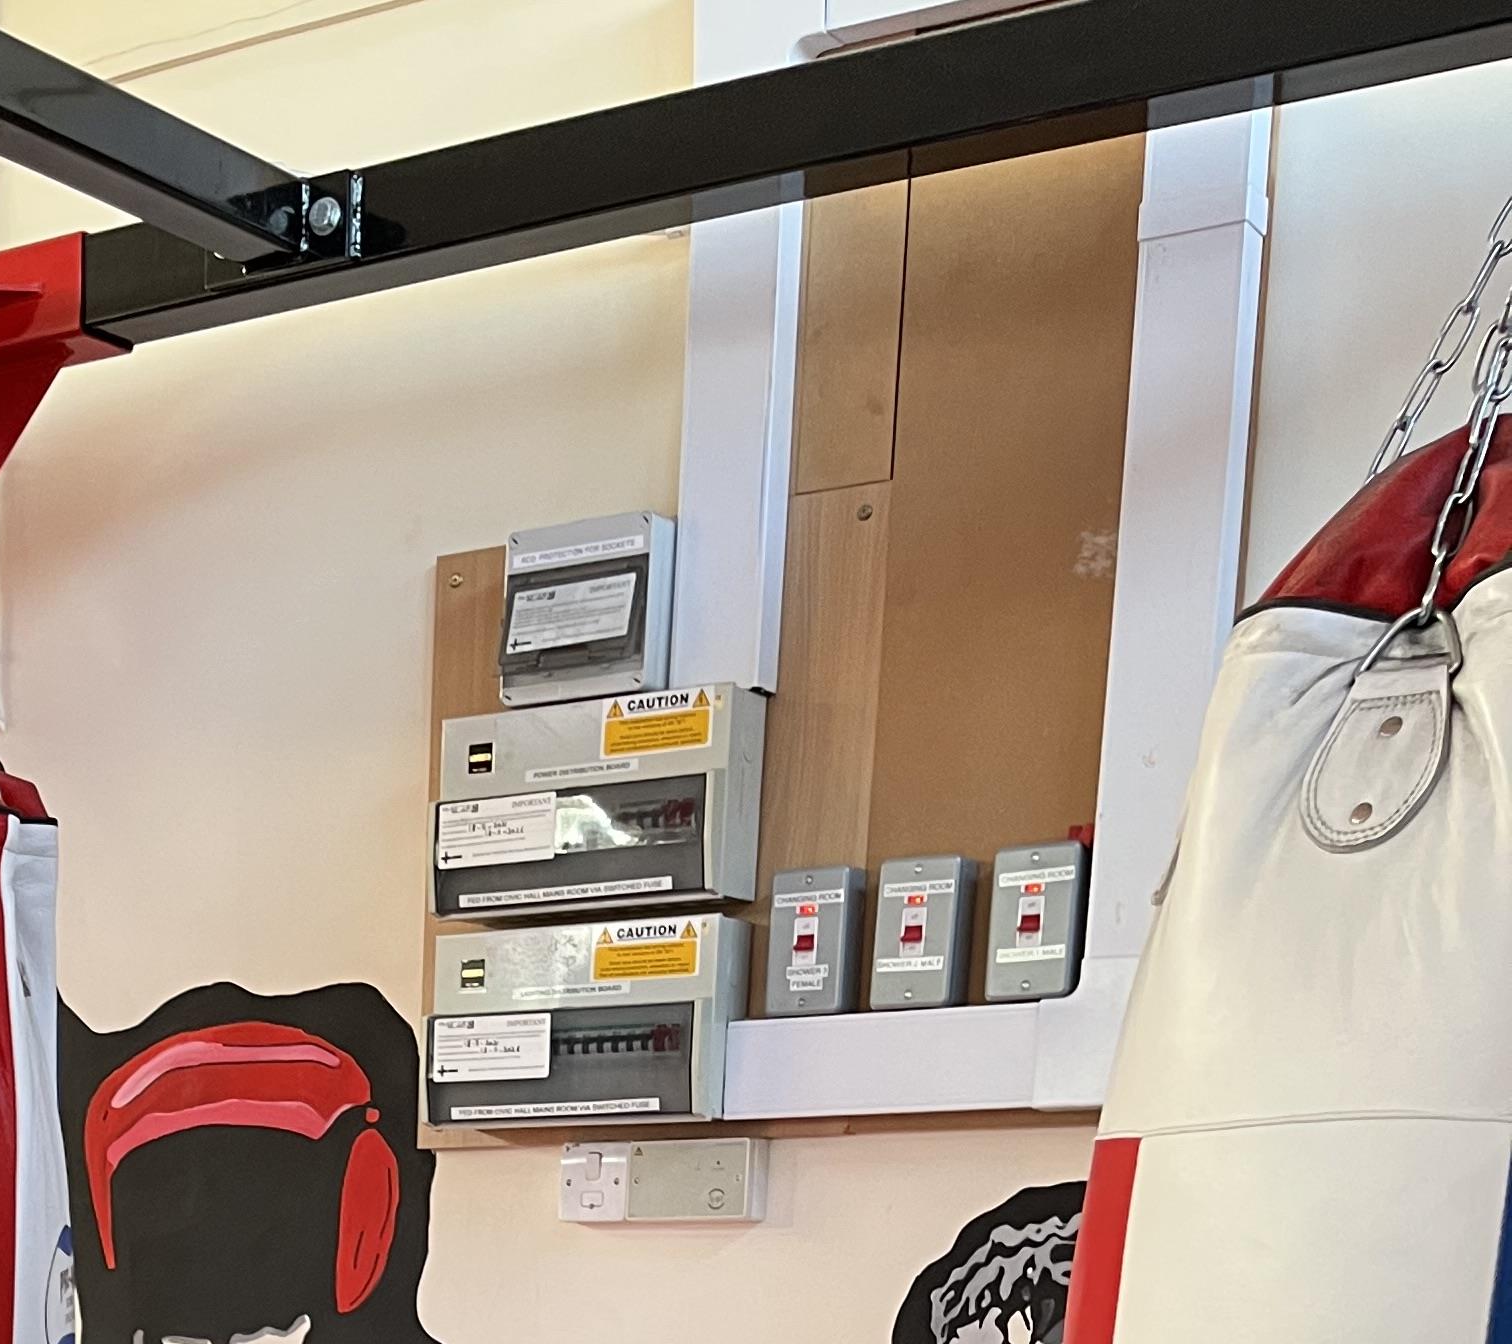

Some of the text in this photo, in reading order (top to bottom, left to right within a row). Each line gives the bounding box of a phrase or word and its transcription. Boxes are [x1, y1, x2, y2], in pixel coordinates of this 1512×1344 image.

[539, 548, 583, 561] PROTECTION
[601, 539, 635, 551] SOCKETS
[627, 693, 689, 712] CAUTION
[482, 894, 503, 903] FROM
[524, 890, 541, 900] HALL
[543, 889, 565, 898] MAINS
[566, 887, 589, 897] ROOM
[603, 882, 642, 893] SWITCHED
[928, 881, 953, 891] ROOM
[818, 892, 842, 902] ROOM
[617, 924, 677, 940] CAUTION
[791, 979, 822, 988] FEMALE
[514, 1107, 531, 1115] HALL
[533, 1106, 555, 1114] MAINS
[556, 1105, 578, 1113] ROOM
